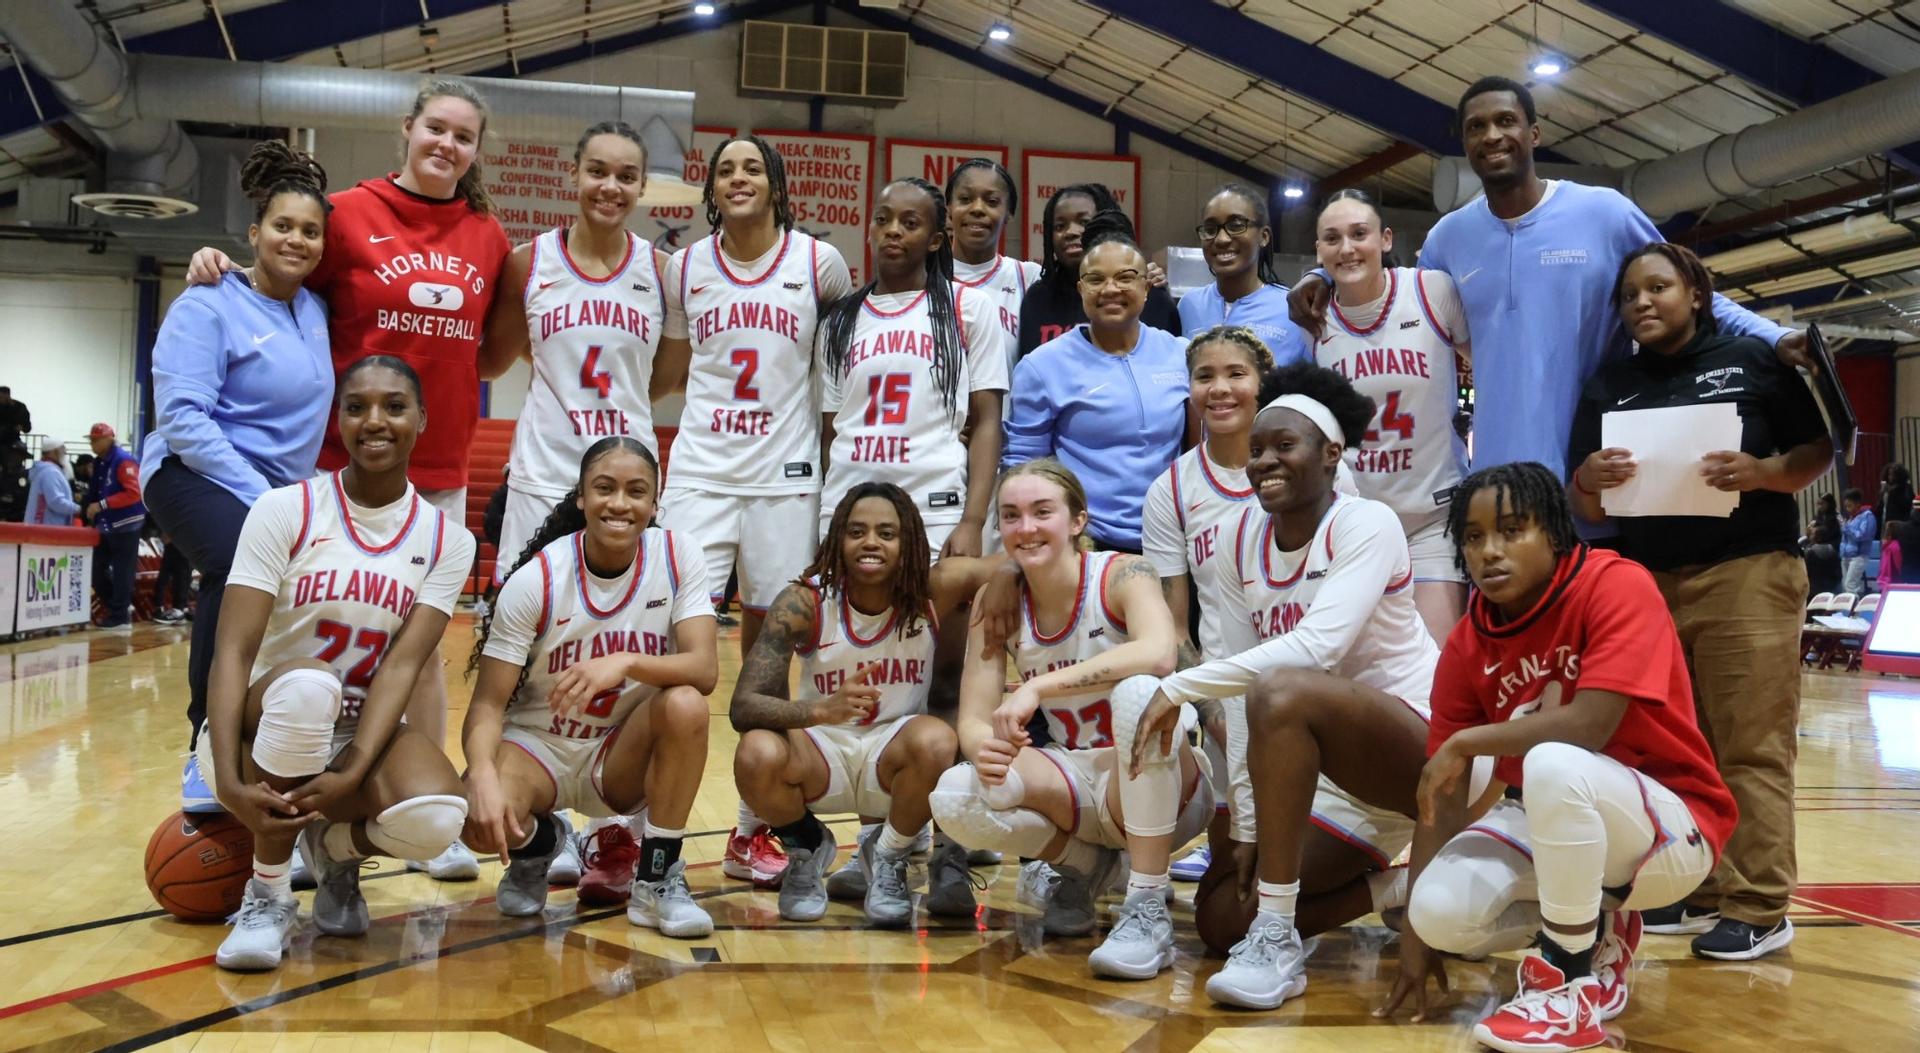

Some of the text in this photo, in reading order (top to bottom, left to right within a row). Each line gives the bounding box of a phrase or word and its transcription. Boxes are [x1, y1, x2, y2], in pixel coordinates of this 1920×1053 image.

[508, 143, 559, 158] DELAWARE
[521, 157, 535, 169] OF
[537, 159, 554, 171] THE
[813, 143, 851, 160] MEN'S
[500, 171, 563, 188] CONFERENCE
[786, 160, 861, 181] NFERENCE
[520, 185, 533, 197] OF
[535, 187, 553, 200] THE
[788, 180, 858, 201] AMPIONS
[499, 208, 528, 225] SHA
[788, 202, 860, 226] 05-2006
[373, 251, 484, 295] HORNETS
[377, 309, 475, 341] BASKETBALL
[541, 299, 650, 345] DELAWARE
[696, 302, 799, 346] DELAWARE
[580, 345, 613, 399] 4
[730, 348, 760, 401] 2
[864, 372, 912, 427] 15
[568, 409, 630, 437] STATE
[711, 408, 773, 436] STATE
[851, 436, 911, 463] STATE
[1355, 448, 1413, 473] STATE
[26, 556, 67, 602] DART
[294, 569, 416, 622] DELAWAR
[549, 714, 609, 740] STAT
